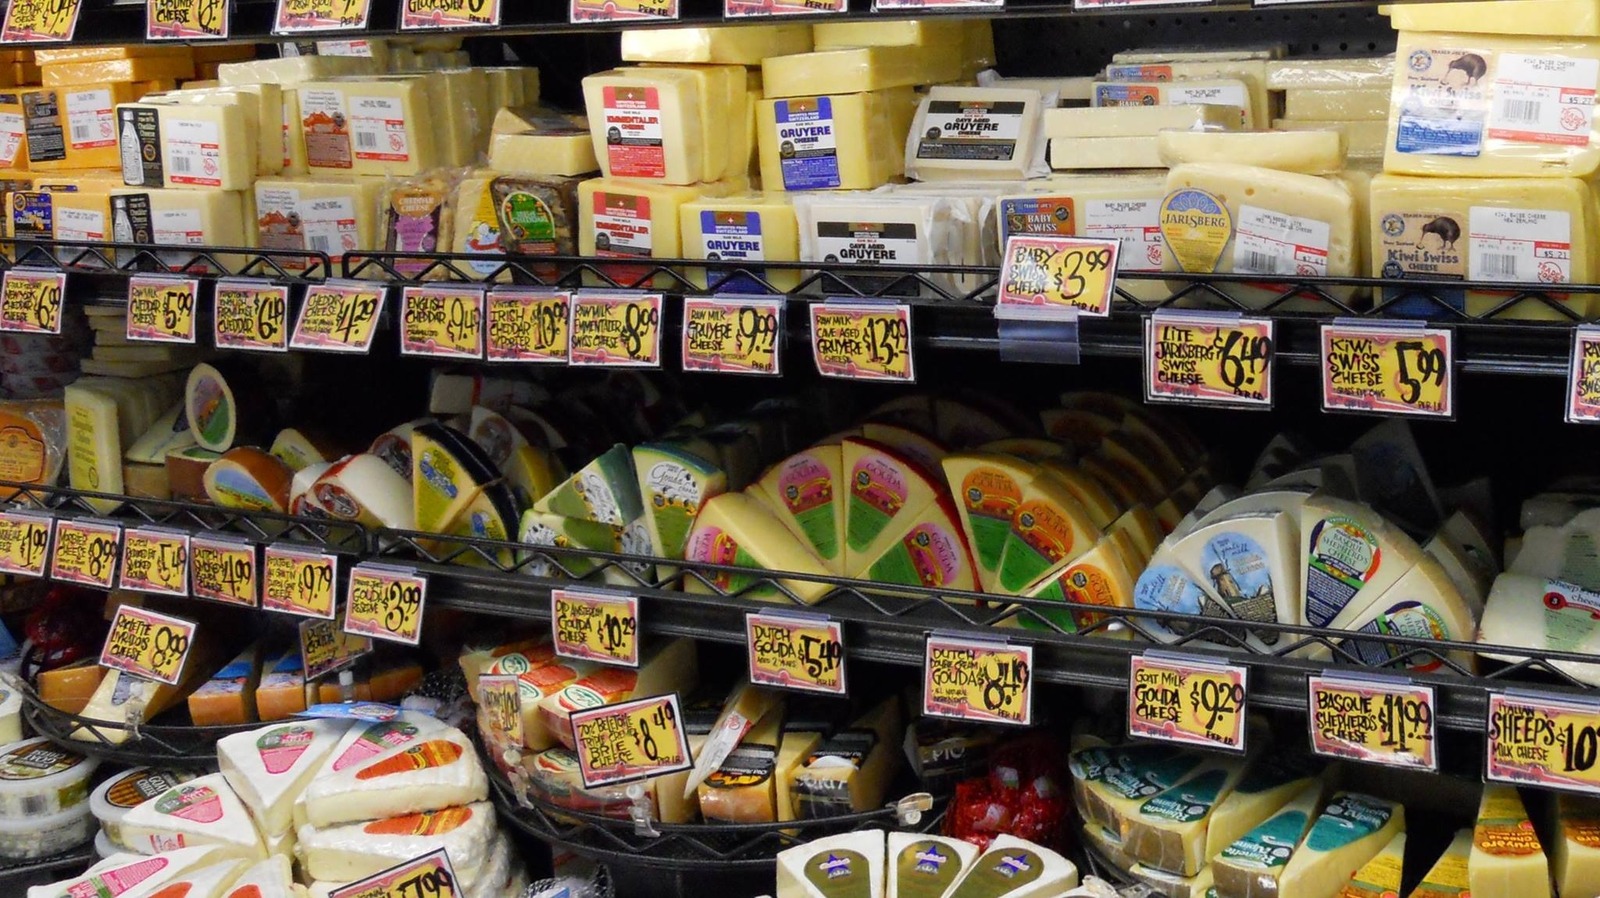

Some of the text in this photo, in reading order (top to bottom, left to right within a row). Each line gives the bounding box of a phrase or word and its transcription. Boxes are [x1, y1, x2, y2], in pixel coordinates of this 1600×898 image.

[408, 0, 462, 12] GLOUCESTER
[157, 8, 190, 24] CHEESE
[780, 127, 832, 138] GRUYERE
[944, 122, 998, 132] GRUYERE
[1028, 214, 1051, 223] BABY
[1028, 223, 1057, 233] SWISS
[707, 241, 759, 252] GRUYERE
[840, 249, 896, 261] GRUYERE
[1015, 246, 1059, 264] BABY
[1388, 249, 1459, 265] Kiwi Swiss
[1010, 264, 1049, 280] SWISS
[1408, 263, 1438, 272] CHEESE
[1005, 281, 1049, 296] CHEESE
[131, 300, 161, 314] CHEDDAR
[407, 297, 445, 310] ENGLISH
[3, 312, 28, 322] CHEESE
[132, 314, 156, 326] CHEESE
[305, 306, 336, 318] CHEESE
[405, 311, 446, 326] CHEDDAR
[490, 309, 525, 323] IRISH
[692, 310, 726, 322] RAW MILK
[816, 315, 852, 326] RAW MILK
[490, 323, 530, 337] CHEDDAR
[687, 322, 733, 340] GRUYERE
[817, 328, 860, 339] CAVE AGED
[571, 336, 617, 350] SWISS CHEESE
[690, 340, 725, 351] CHEESE
[817, 338, 864, 356] GRUYERE
[1155, 341, 1215, 362] JARLSBERG
[1158, 371, 1206, 386] CHEESE
[1331, 370, 1383, 386] CHEESE
[652, 465, 683, 485] Gouda
[866, 463, 900, 489] GOUDA
[1334, 533, 1363, 550] BASQUE
[931, 533, 954, 574] GOUDA
[1322, 537, 1369, 565] SHEPHERD'S
[1327, 549, 1356, 567] CHEESE
[353, 588, 383, 602] GOUDA
[558, 614, 593, 632] GOUDA
[559, 630, 587, 643] CHEESE
[753, 625, 791, 642] DUTCH
[110, 644, 142, 662] CHEESE
[754, 639, 796, 658] GOUDA
[933, 648, 975, 661] DUTCH
[932, 668, 978, 687] GOUDA
[1135, 669, 1159, 685] GOAT
[1135, 684, 1182, 709] GOUDA
[1316, 691, 1373, 714] BASQUE
[1136, 703, 1182, 723] CHEESE
[1498, 702, 1535, 717] ITALIAN
[1316, 712, 1378, 732] SHEPHERD'S
[1488, 712, 1555, 746] SHEEP'S
[1322, 728, 1369, 744] CHEESE
[590, 741, 627, 758] BRIE
[1492, 742, 1550, 761] MILK CHEESE
[589, 751, 635, 770] CHEESE
